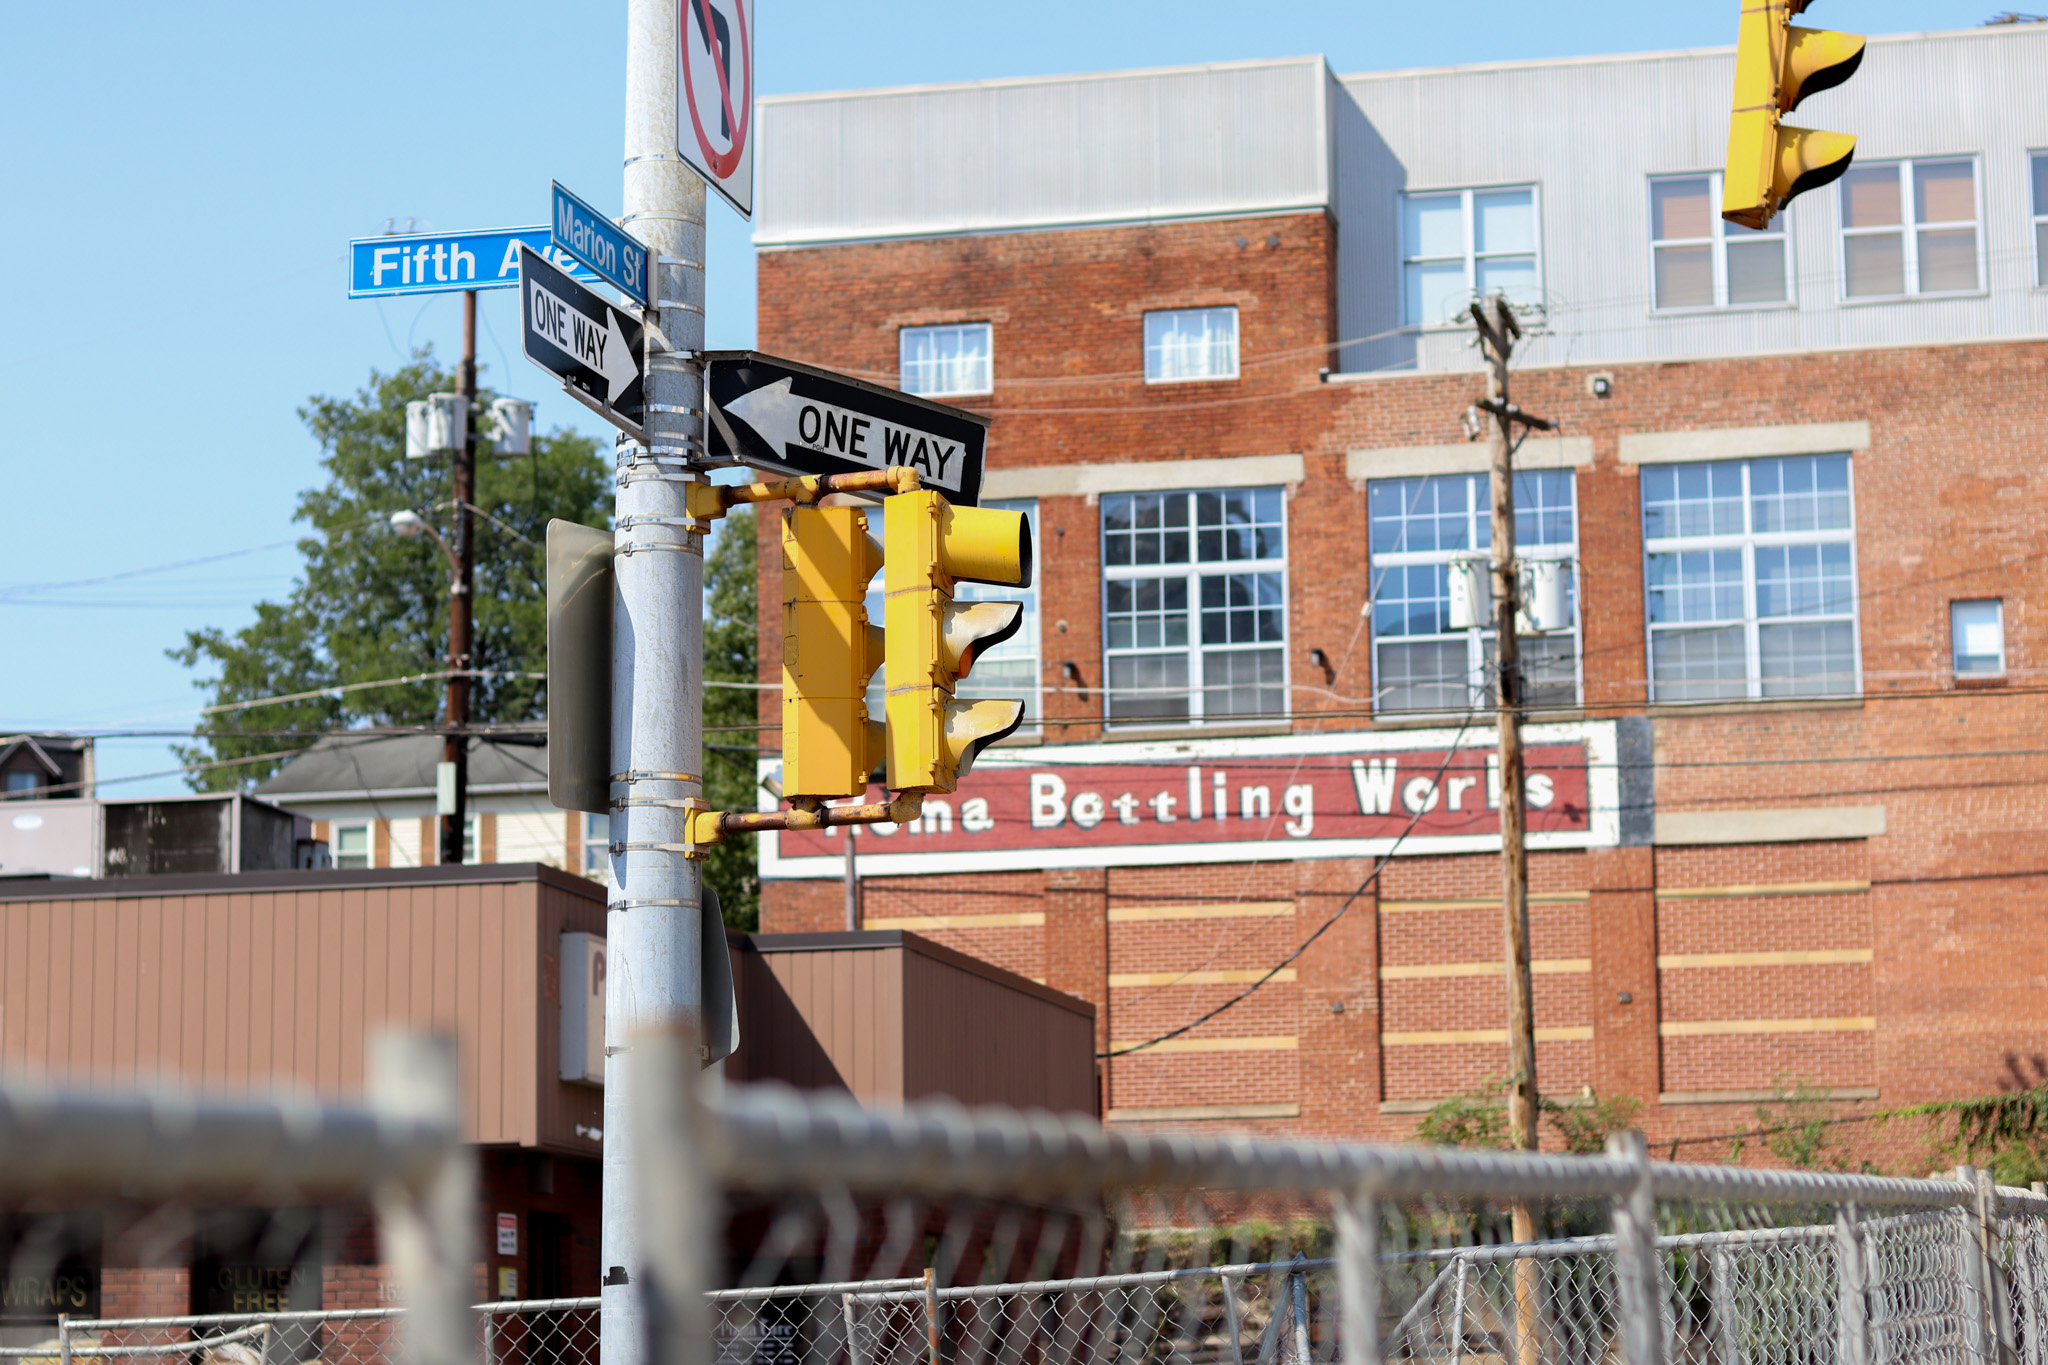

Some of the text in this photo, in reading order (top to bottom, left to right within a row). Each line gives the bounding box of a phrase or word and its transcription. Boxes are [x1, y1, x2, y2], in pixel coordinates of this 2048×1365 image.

[373, 242, 476, 286] Fifth
[558, 196, 641, 293] Marion St
[535, 289, 607, 370] ONE WAY
[799, 405, 956, 481] ONE WAY
[812, 443, 825, 452] PGH
[1030, 765, 1314, 837] Bottling
[0, 1275, 87, 1308] WRAPS
[217, 1265, 306, 1289] GLUTEN
[233, 1289, 290, 1312] FREE
